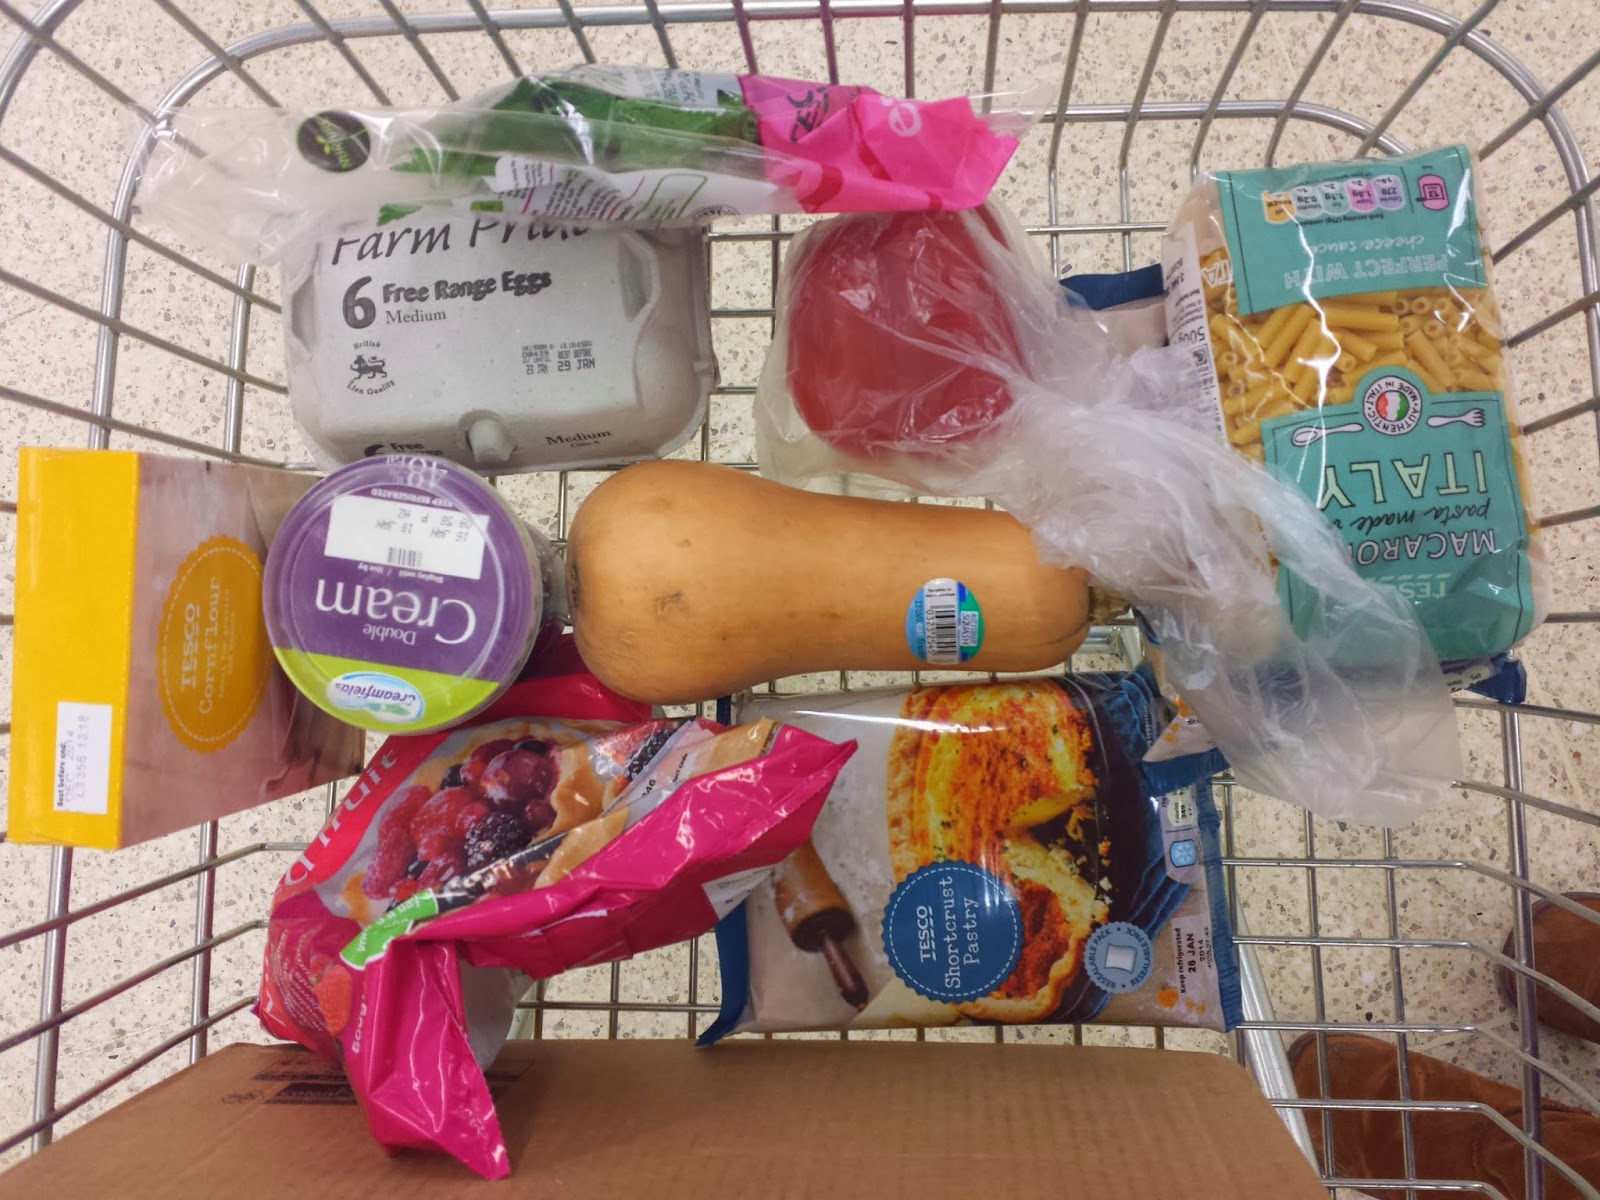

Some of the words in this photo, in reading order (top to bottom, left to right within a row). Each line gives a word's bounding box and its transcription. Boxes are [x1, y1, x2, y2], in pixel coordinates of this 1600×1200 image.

[1361, 234, 1425, 250] cheese
[1353, 253, 1450, 278] PERFECT
[382, 283, 430, 304] Free
[434, 275, 497, 301] Range
[501, 270, 553, 297] Eggs
[342, 276, 377, 329] 6
[385, 309, 447, 324] Medium
[353, 339, 381, 350] British
[557, 350, 571, 360] BEST
[573, 347, 593, 359] BEFORE
[557, 360, 572, 372] 29
[576, 357, 596, 370] JAN
[346, 381, 364, 394] Lion
[366, 379, 396, 395] Quality
[1365, 383, 1383, 406] ITALY
[1397, 382, 1419, 402] MADE
[1367, 407, 1420, 433] AUTHENTIC
[389, 442, 425, 450] Free
[544, 431, 612, 445] Medium
[1316, 450, 1488, 511] ITALY
[370, 488, 431, 503] REFRIGERATED
[1350, 509, 1416, 535] made
[1425, 497, 1491, 527] pasta
[375, 519, 397, 531] JAN
[430, 528, 450, 540] JAN
[1347, 528, 1497, 567] MACARO
[1399, 577, 1448, 599] TES
[314, 579, 477, 645] Cream
[363, 623, 417, 646] Double
[961, 613, 970, 645] SQUASH
[181, 602, 197, 693] TESCO
[199, 576, 220, 714] Cornflour
[58, 761, 66, 788] before
[917, 904, 933, 964] TESCO
[938, 875, 962, 990] Shortcrust
[962, 896, 982, 966] Pastry
[1092, 928, 1112, 946] PACK
[1126, 927, 1145, 943] PACK
[1174, 927, 1185, 973] refrigerated
[1186, 932, 1196, 957] JAN
[1197, 939, 1206, 962] 2014
[1088, 945, 1117, 989] RESEALABLE
[1129, 940, 1151, 987] RESEALABLE
[1187, 959, 1197, 973] 26
